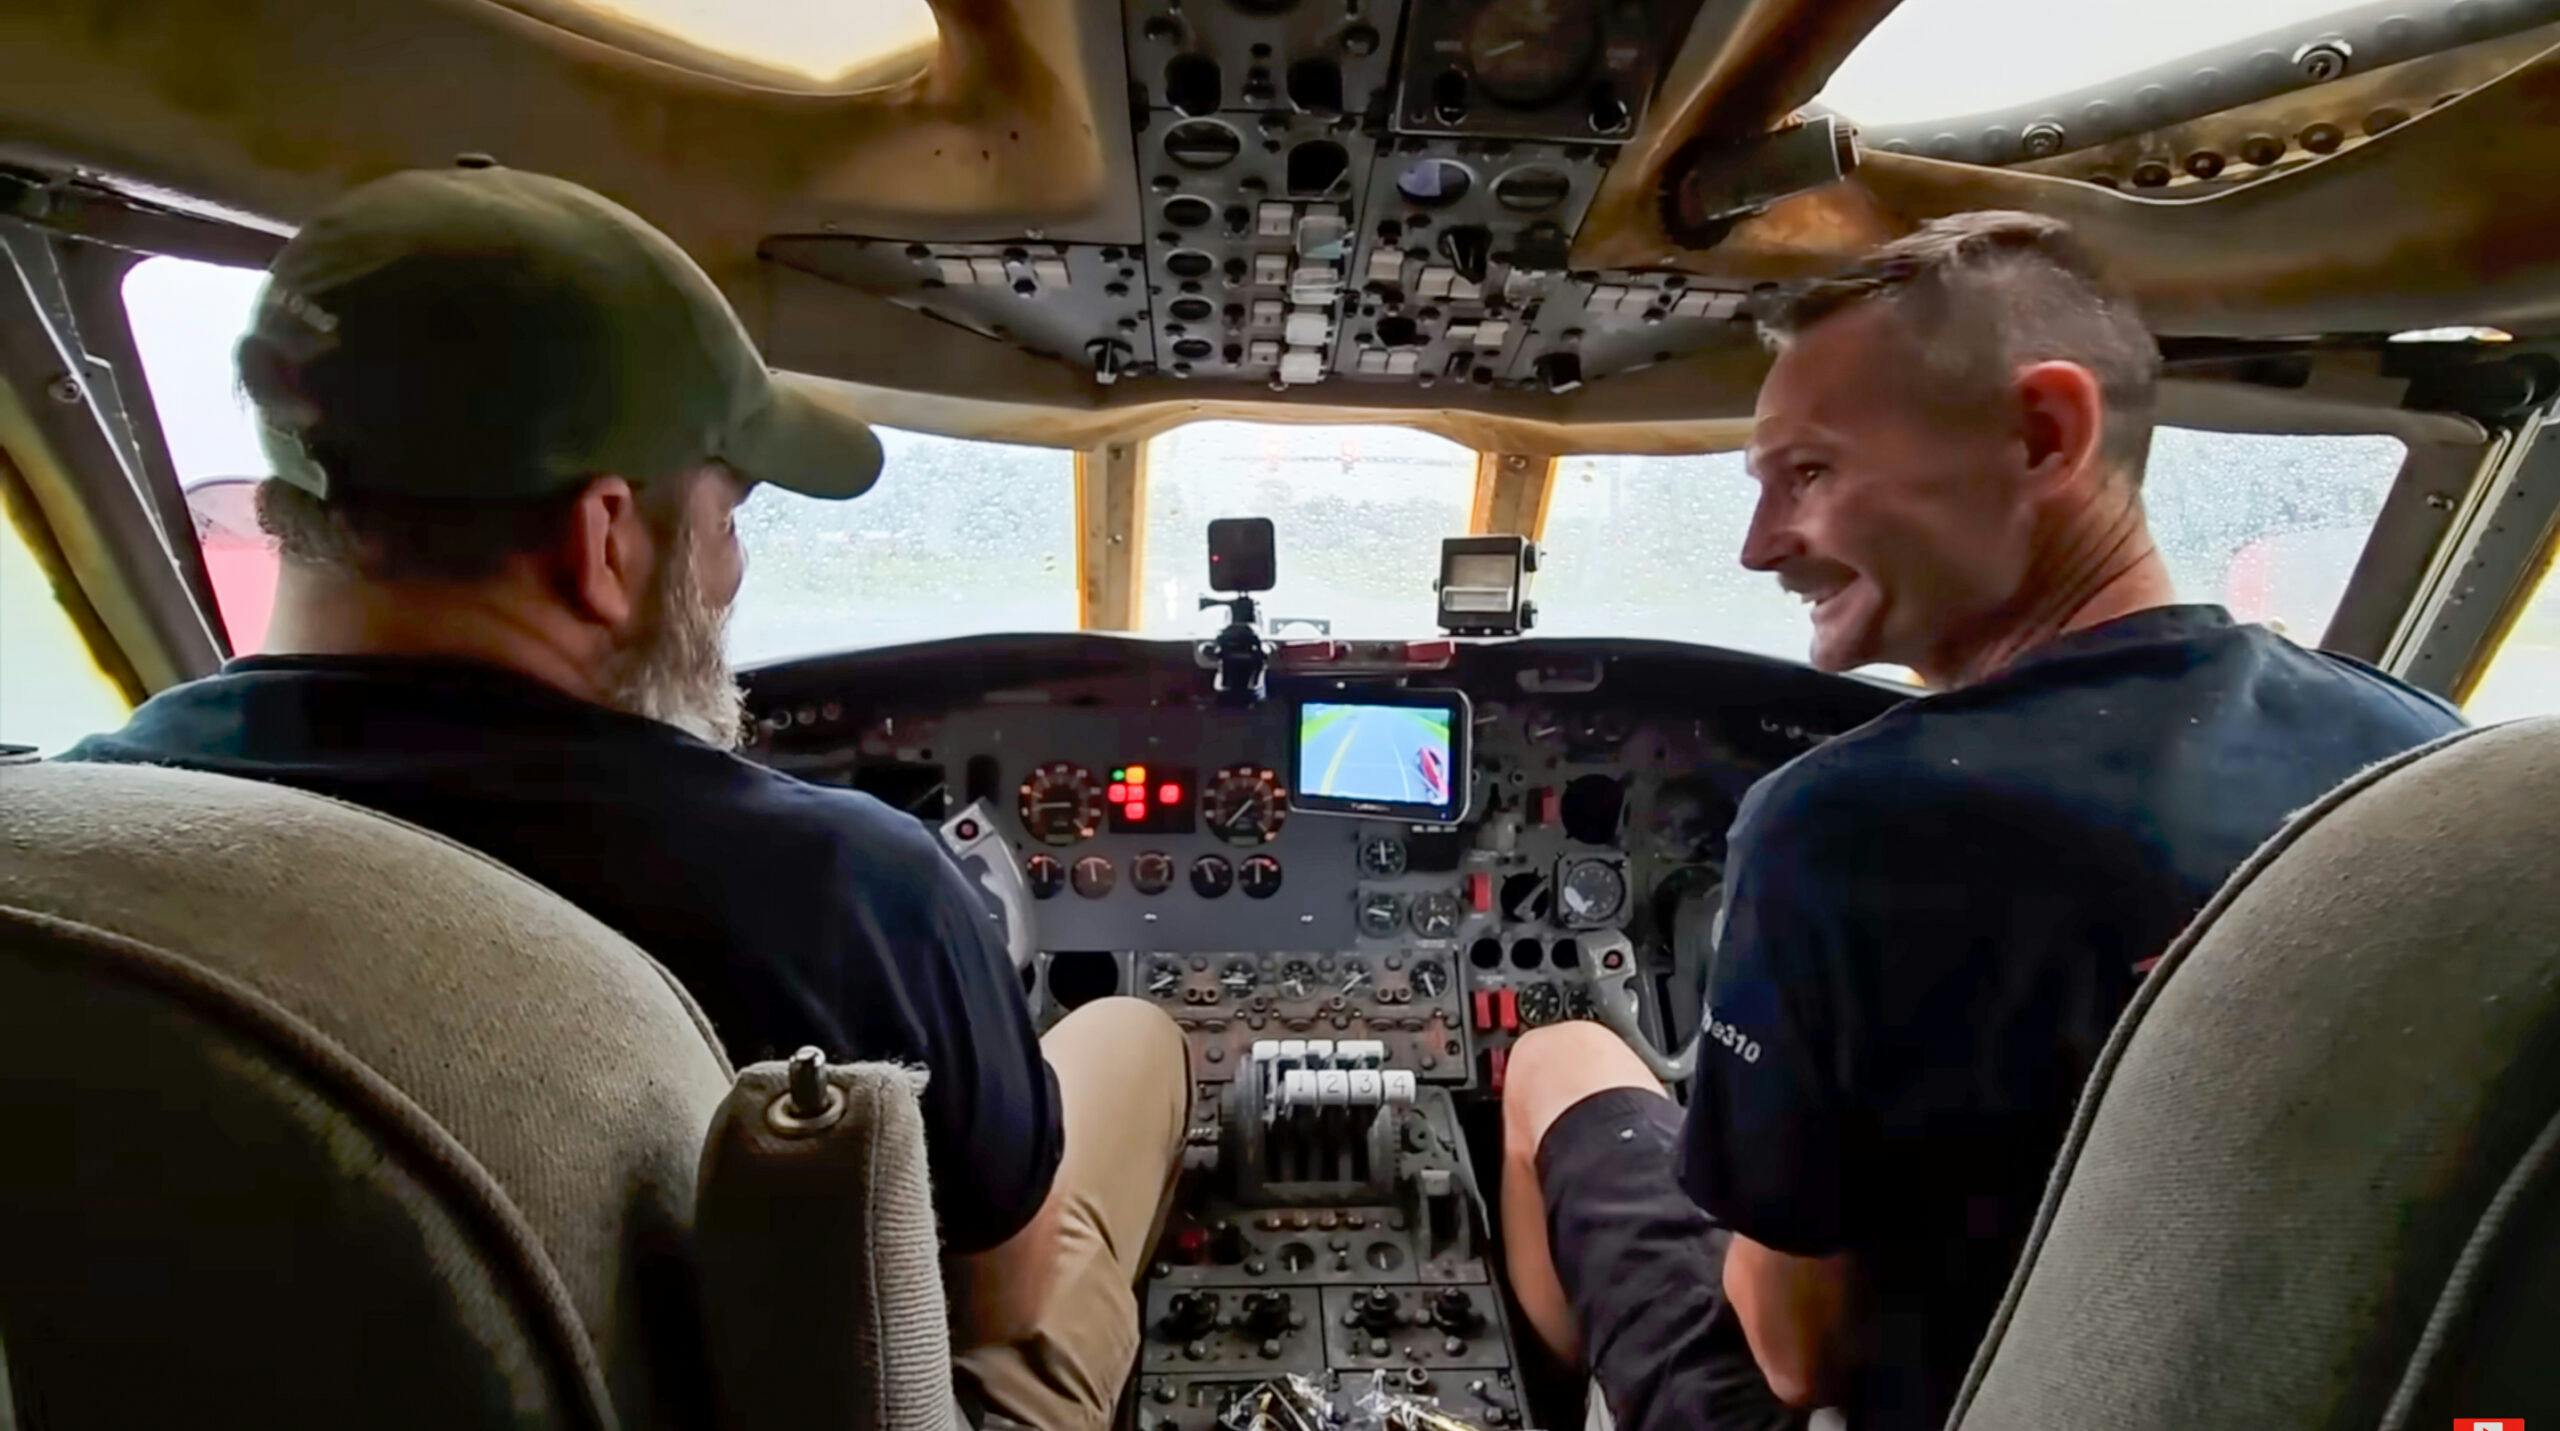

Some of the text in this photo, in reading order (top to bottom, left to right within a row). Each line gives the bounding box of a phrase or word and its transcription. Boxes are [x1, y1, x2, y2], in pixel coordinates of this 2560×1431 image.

[1326, 1074, 1340, 1094] 2
[1360, 1074, 1373, 1094] 3
[1392, 1075, 1406, 1095] 4
